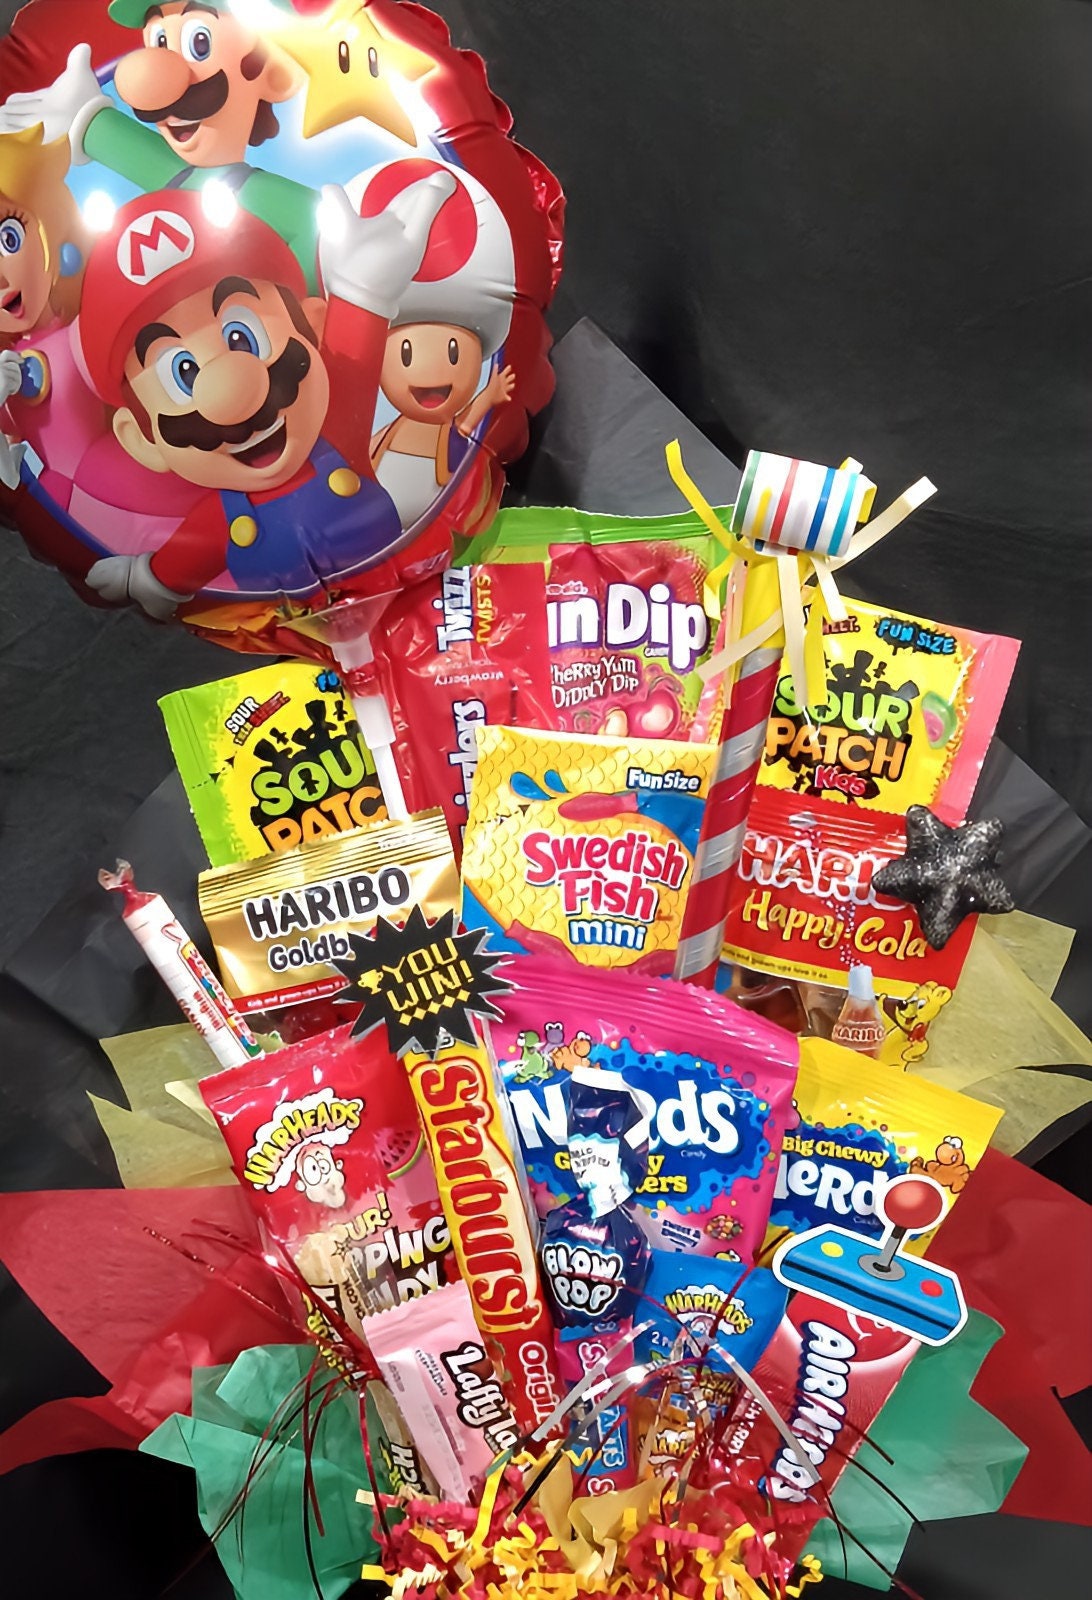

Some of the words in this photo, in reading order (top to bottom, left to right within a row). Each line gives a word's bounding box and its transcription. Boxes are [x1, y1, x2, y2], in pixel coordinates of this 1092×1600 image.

[129, 215, 191, 277] M
[606, 583, 707, 670] Dip
[878, 619, 914, 642] FUN
[601, 655, 638, 676] Yum
[611, 674, 640, 693] Dip
[226, 697, 260, 734] SOUR
[252, 736, 376, 817] SOU
[765, 716, 907, 780] PATCH
[522, 831, 686, 888] Swedish
[738, 832, 905, 911] HARI
[244, 867, 411, 939] HARIBO
[558, 870, 656, 922] Fish
[569, 920, 645, 950] mini
[742, 889, 845, 950] Happy
[854, 917, 927, 961] Cola
[381, 937, 460, 983] YOU
[386, 959, 475, 1012] WIN!
[244, 1101, 362, 1186] WARHEADS
[509, 1079, 739, 1153] Nds
[782, 1136, 815, 1156] Big
[815, 1142, 890, 1169] Chewy
[420, 1064, 541, 1327] Starburst
[543, 1244, 622, 1281] BLOW
[553, 1275, 613, 1310] POP
[443, 1343, 504, 1428] Laffy
